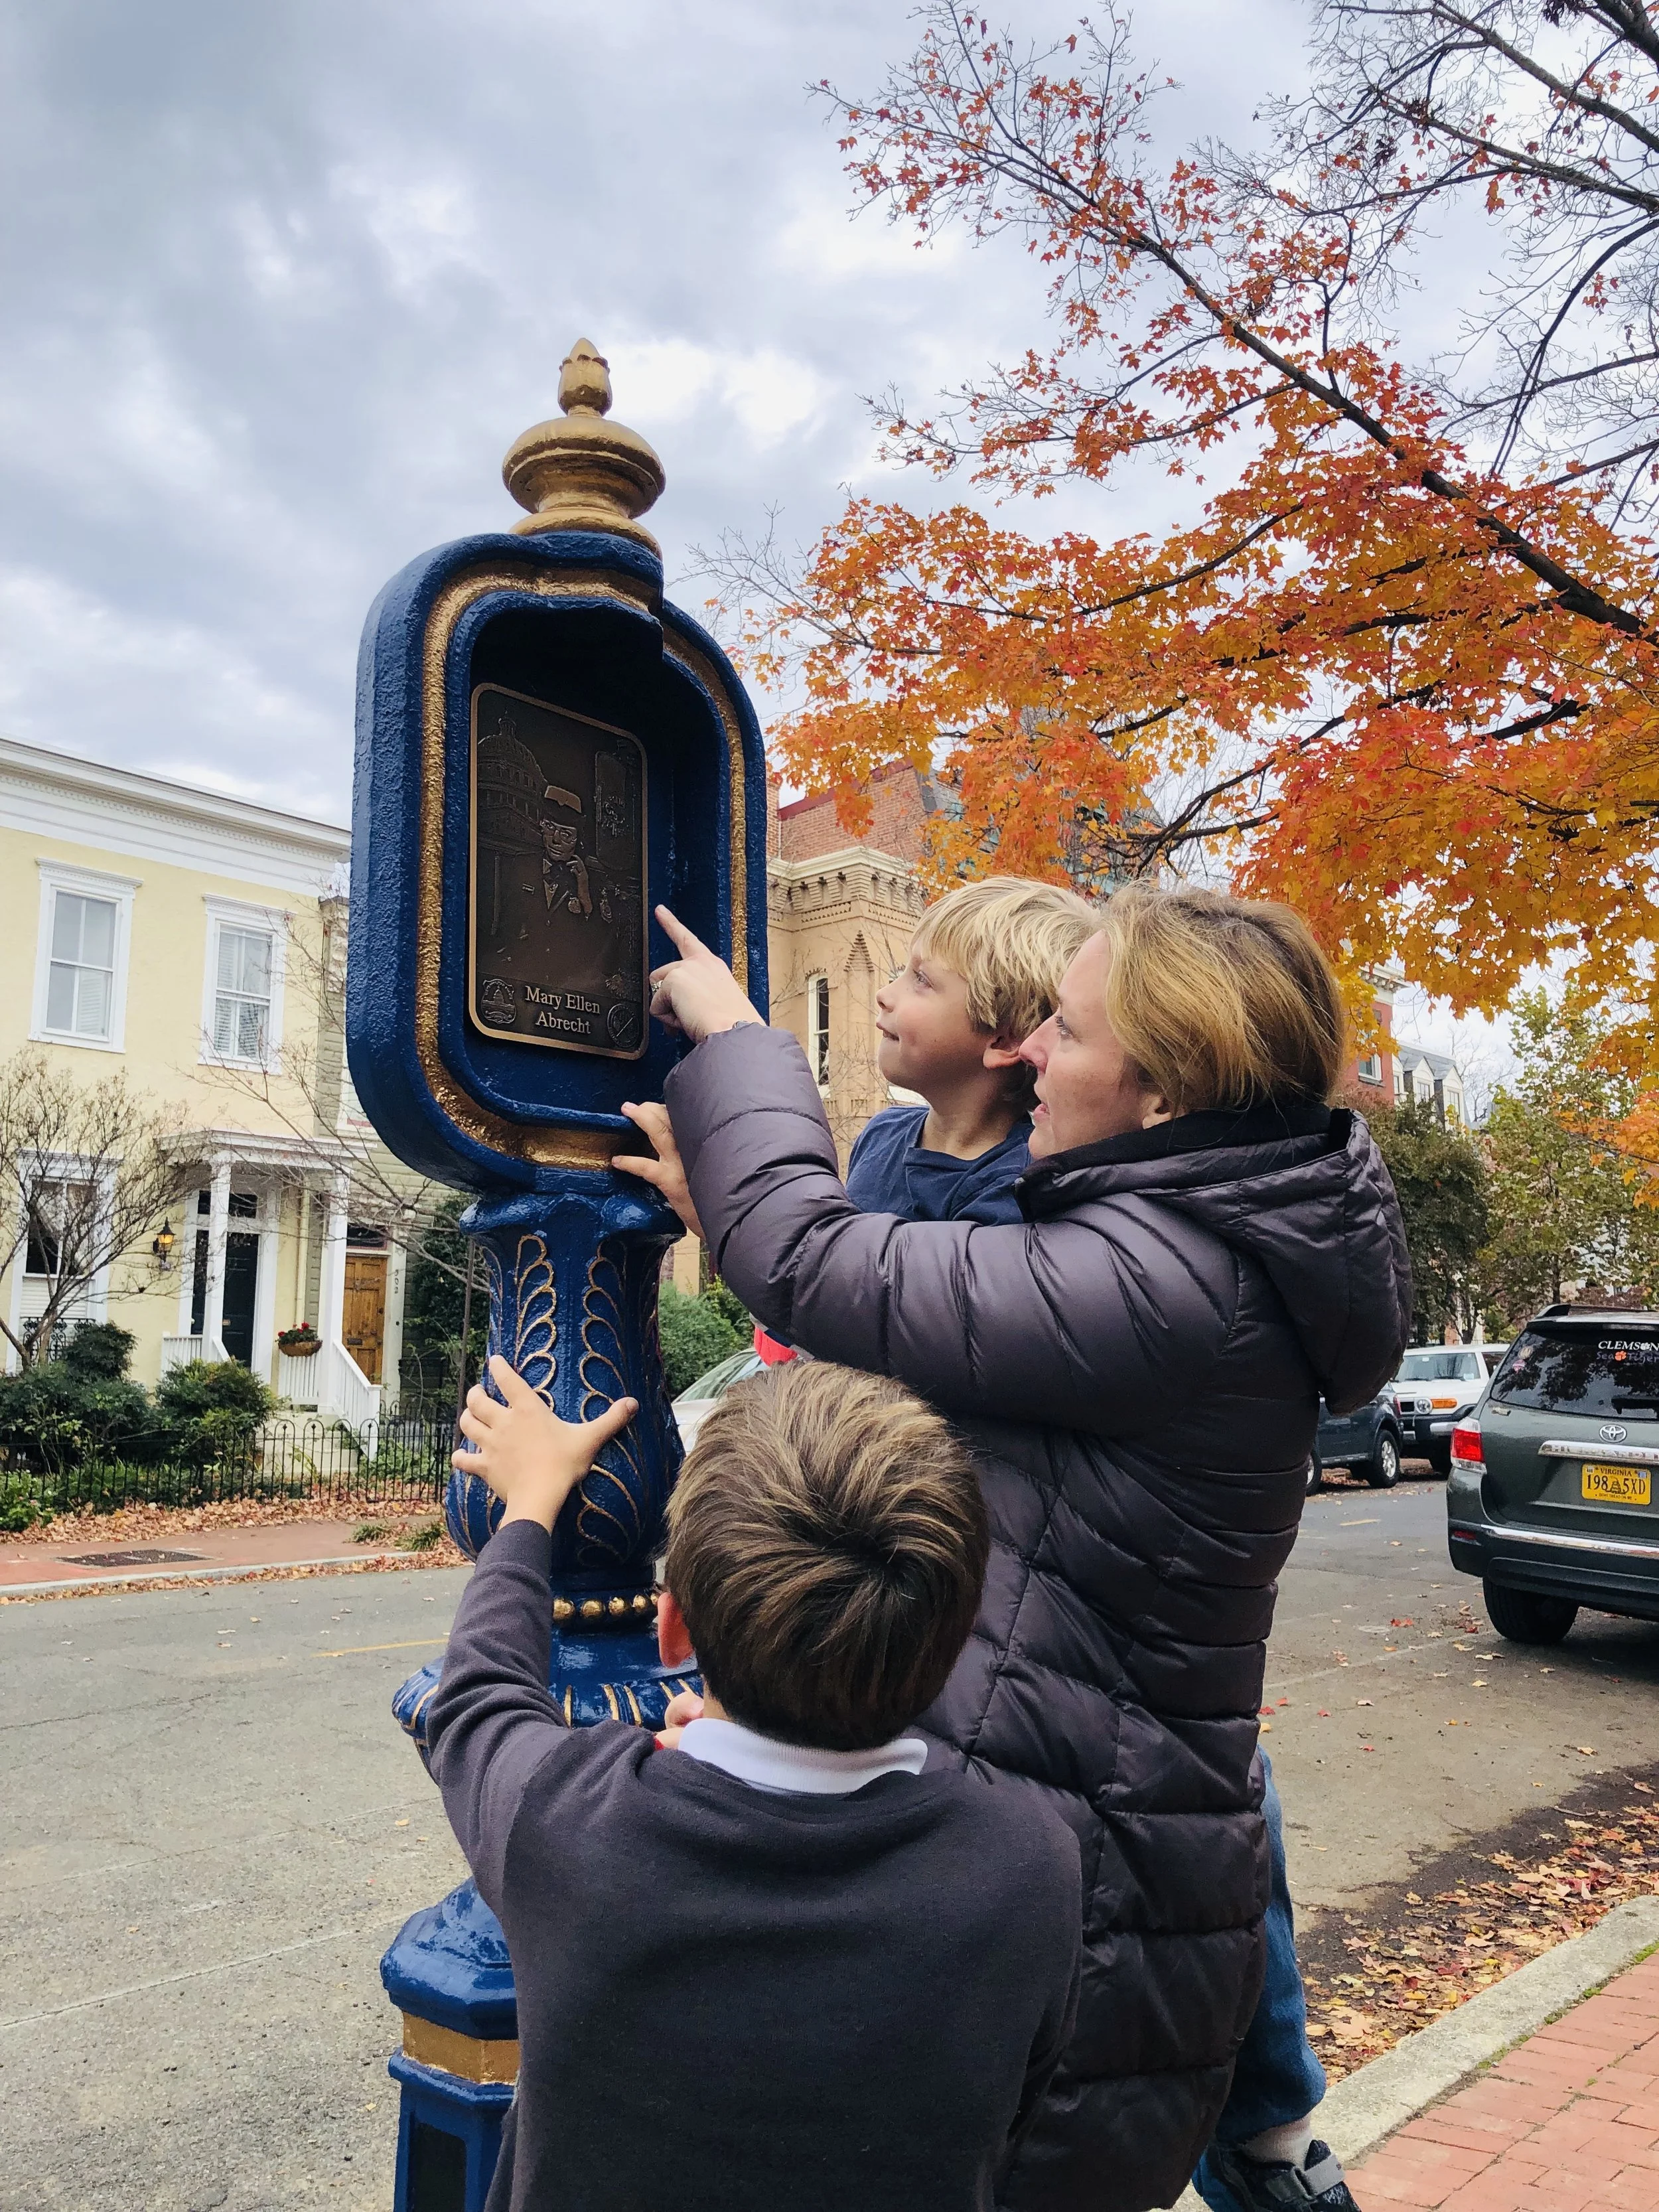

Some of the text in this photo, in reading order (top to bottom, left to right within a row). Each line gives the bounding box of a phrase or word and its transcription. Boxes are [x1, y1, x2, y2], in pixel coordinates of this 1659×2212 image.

[525, 986, 562, 1010] Mary
[565, 994, 601, 1014] Ellen
[535, 1011, 591, 1034] Abrecht
[1600, 1467, 1632, 1477] VIRGINIA
[1587, 1474, 1646, 1495] 198 5XD
